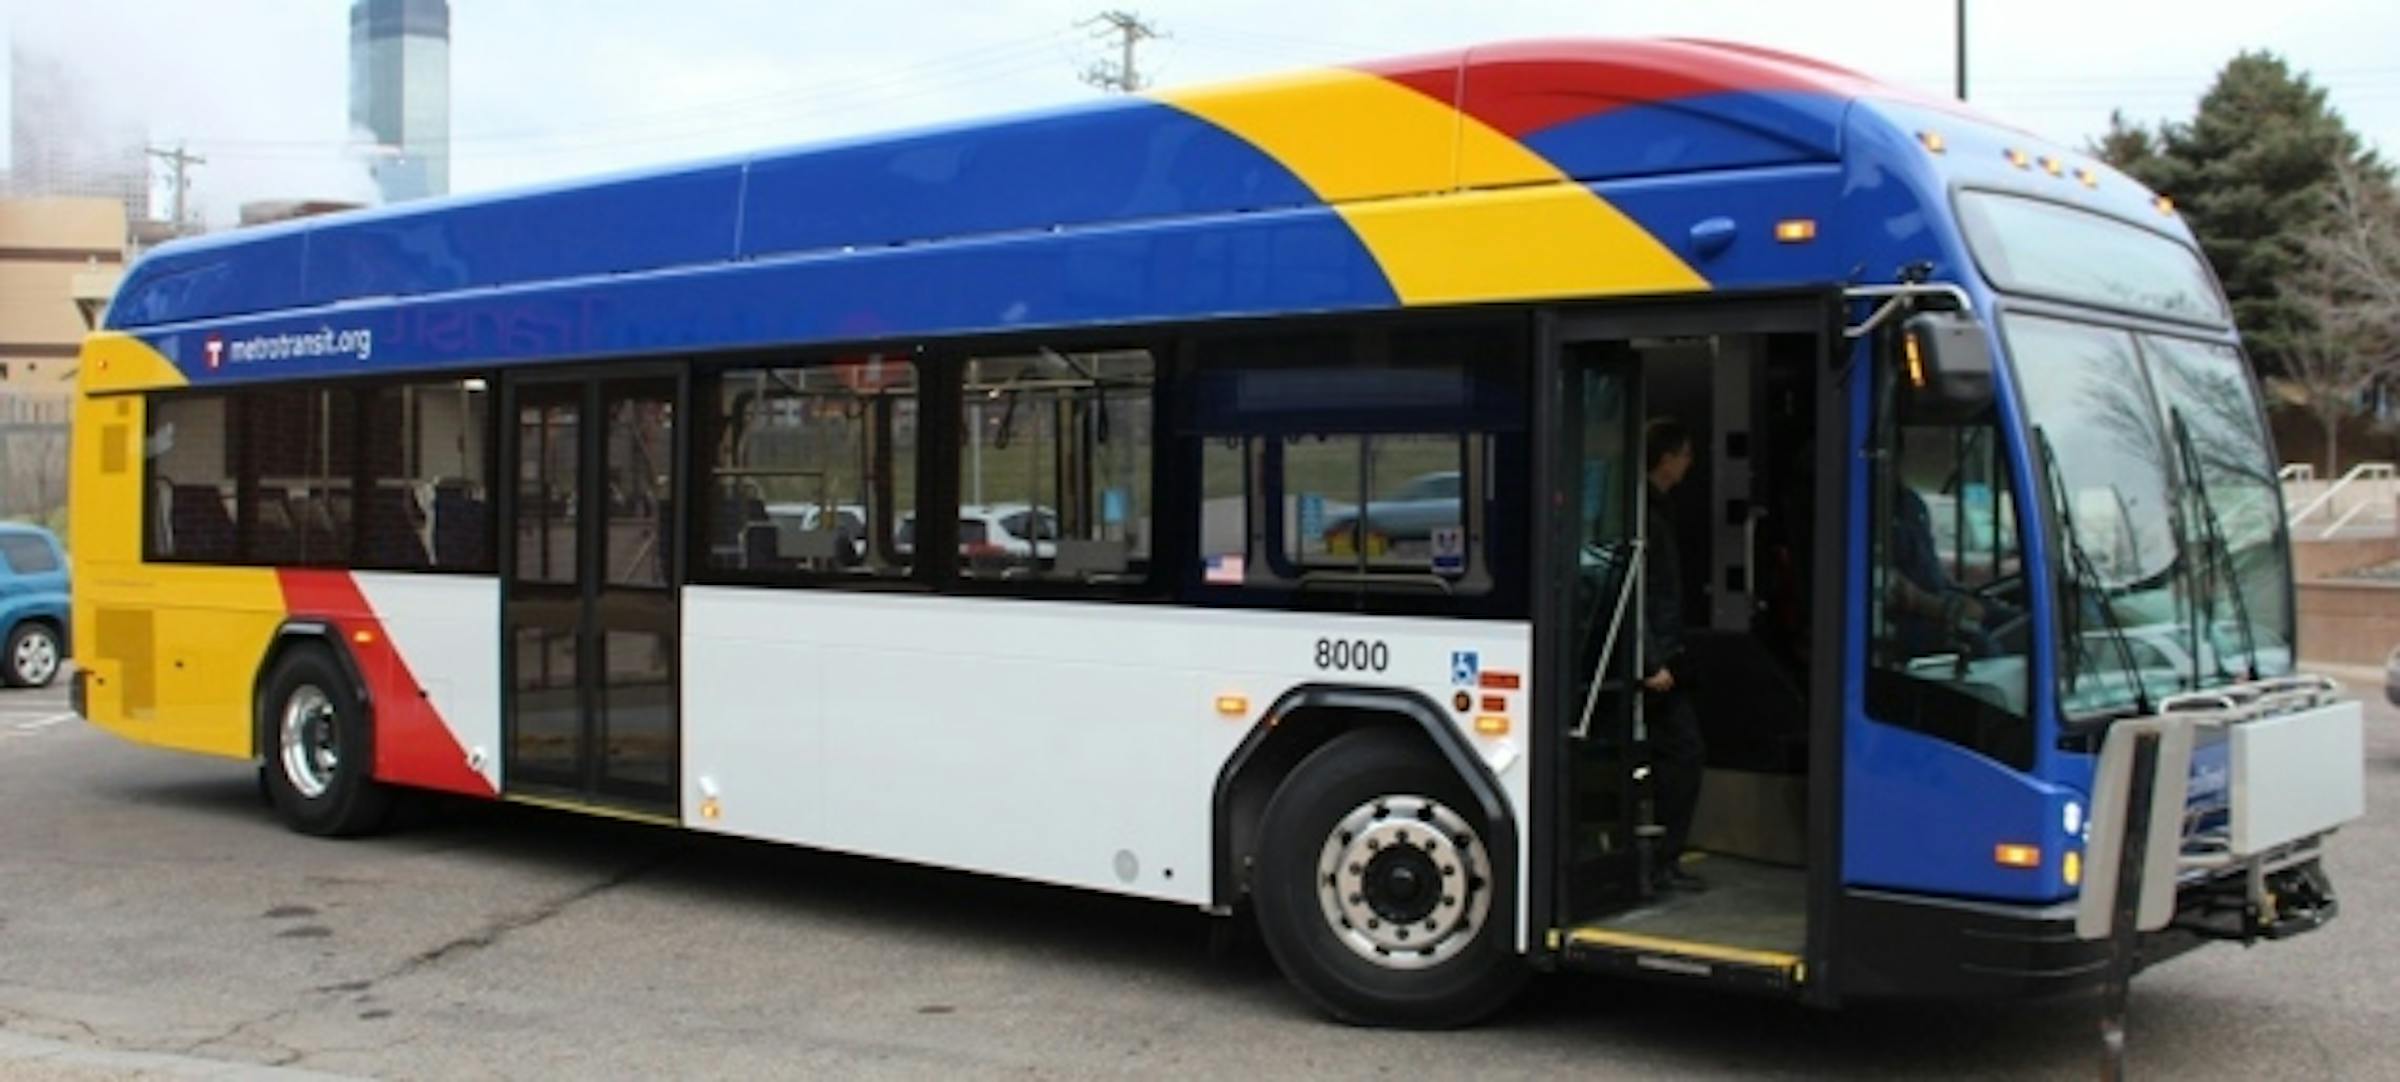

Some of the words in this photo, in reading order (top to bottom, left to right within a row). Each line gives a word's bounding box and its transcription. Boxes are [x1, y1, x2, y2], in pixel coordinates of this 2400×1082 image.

[207, 341, 222, 367] T
[231, 326, 371, 361] metrotransit.org
[1315, 639, 1388, 671] 8000
